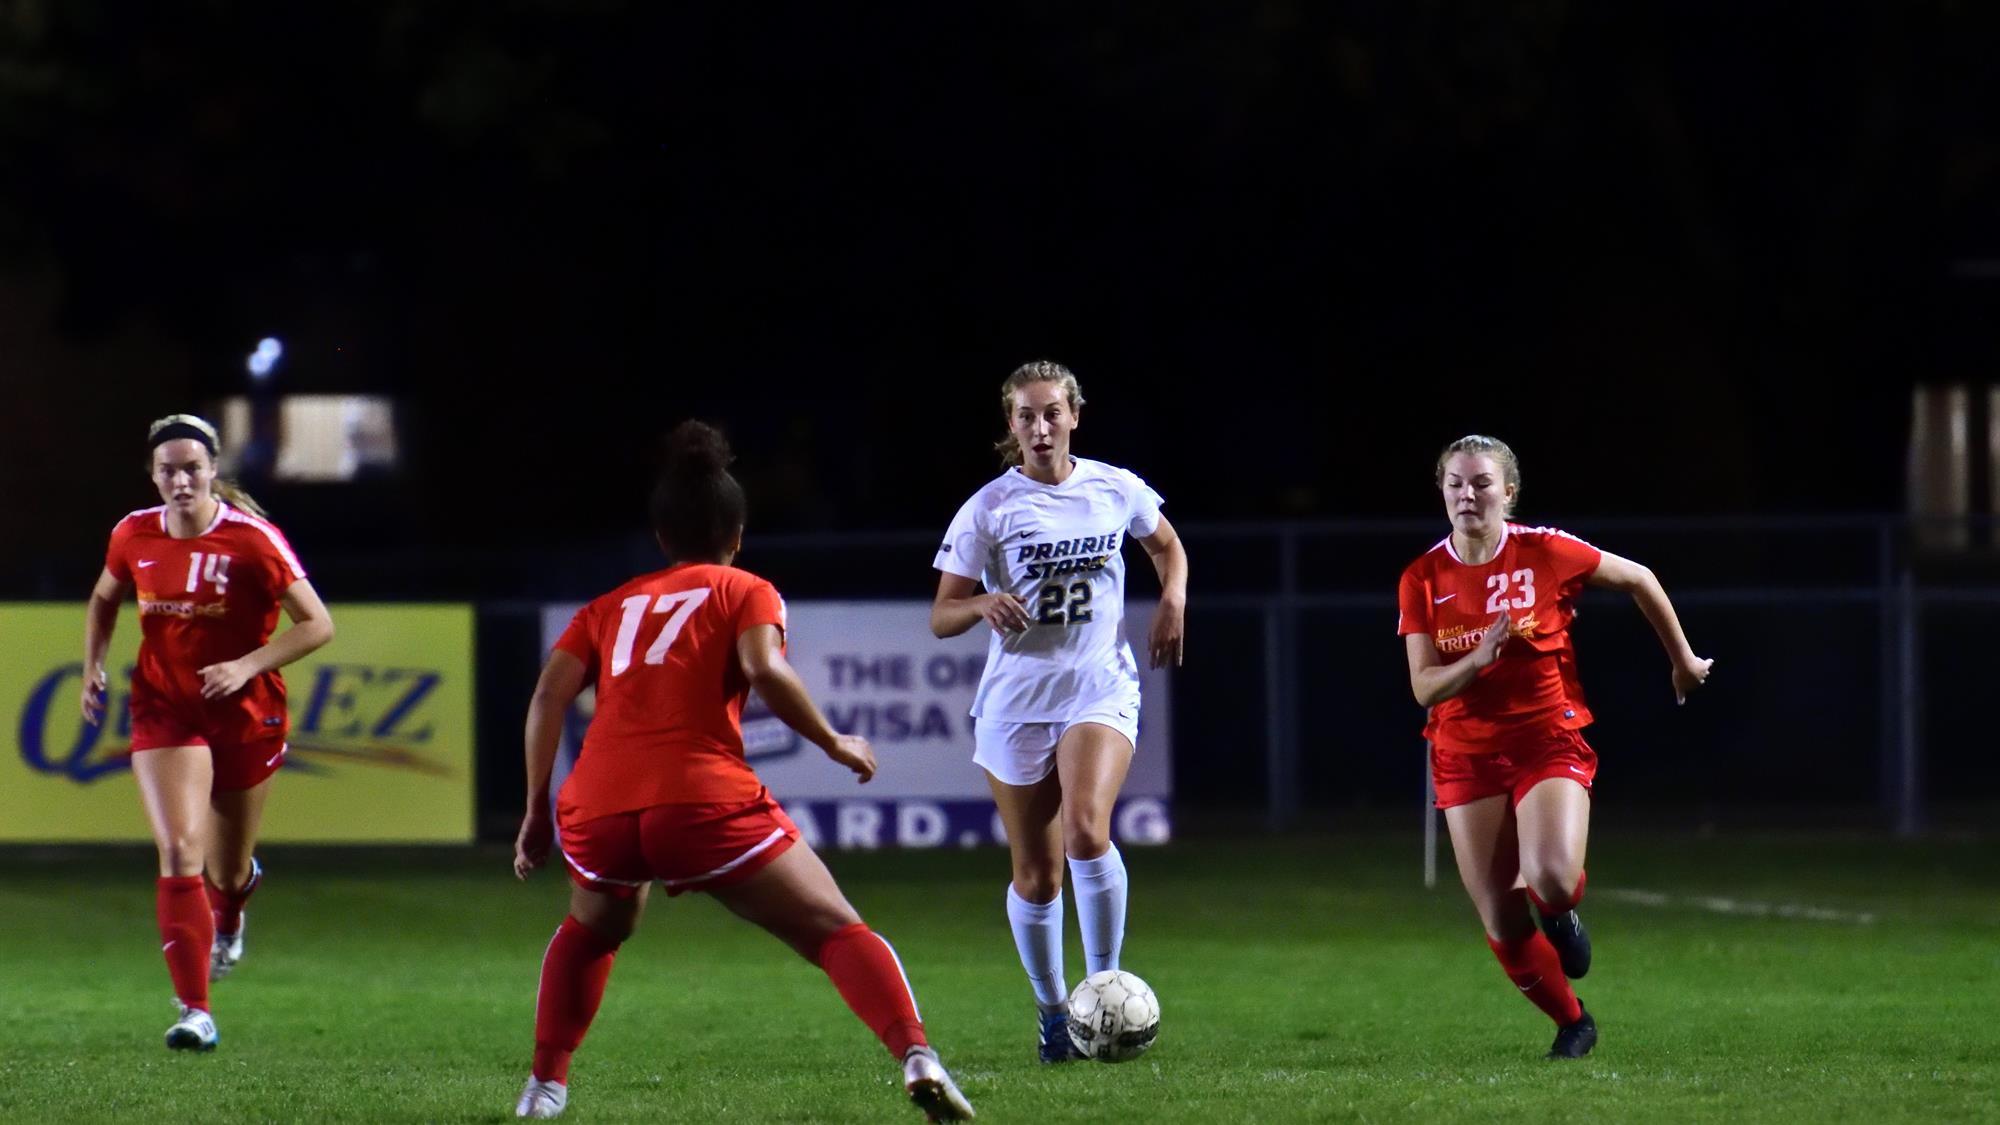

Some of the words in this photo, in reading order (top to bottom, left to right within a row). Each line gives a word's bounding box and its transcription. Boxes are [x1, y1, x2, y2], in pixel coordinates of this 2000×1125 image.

[1016, 533, 1117, 563] PRAIRIE
[186, 552, 231, 594] 14
[1022, 554, 1106, 580] STARS
[1039, 580, 1093, 624] 22
[1486, 568, 1536, 614] 23
[611, 587, 711, 677] 17
[1439, 629, 1489, 652] TRITO
[826, 656, 912, 690] THE
[825, 702, 954, 739] VISA
